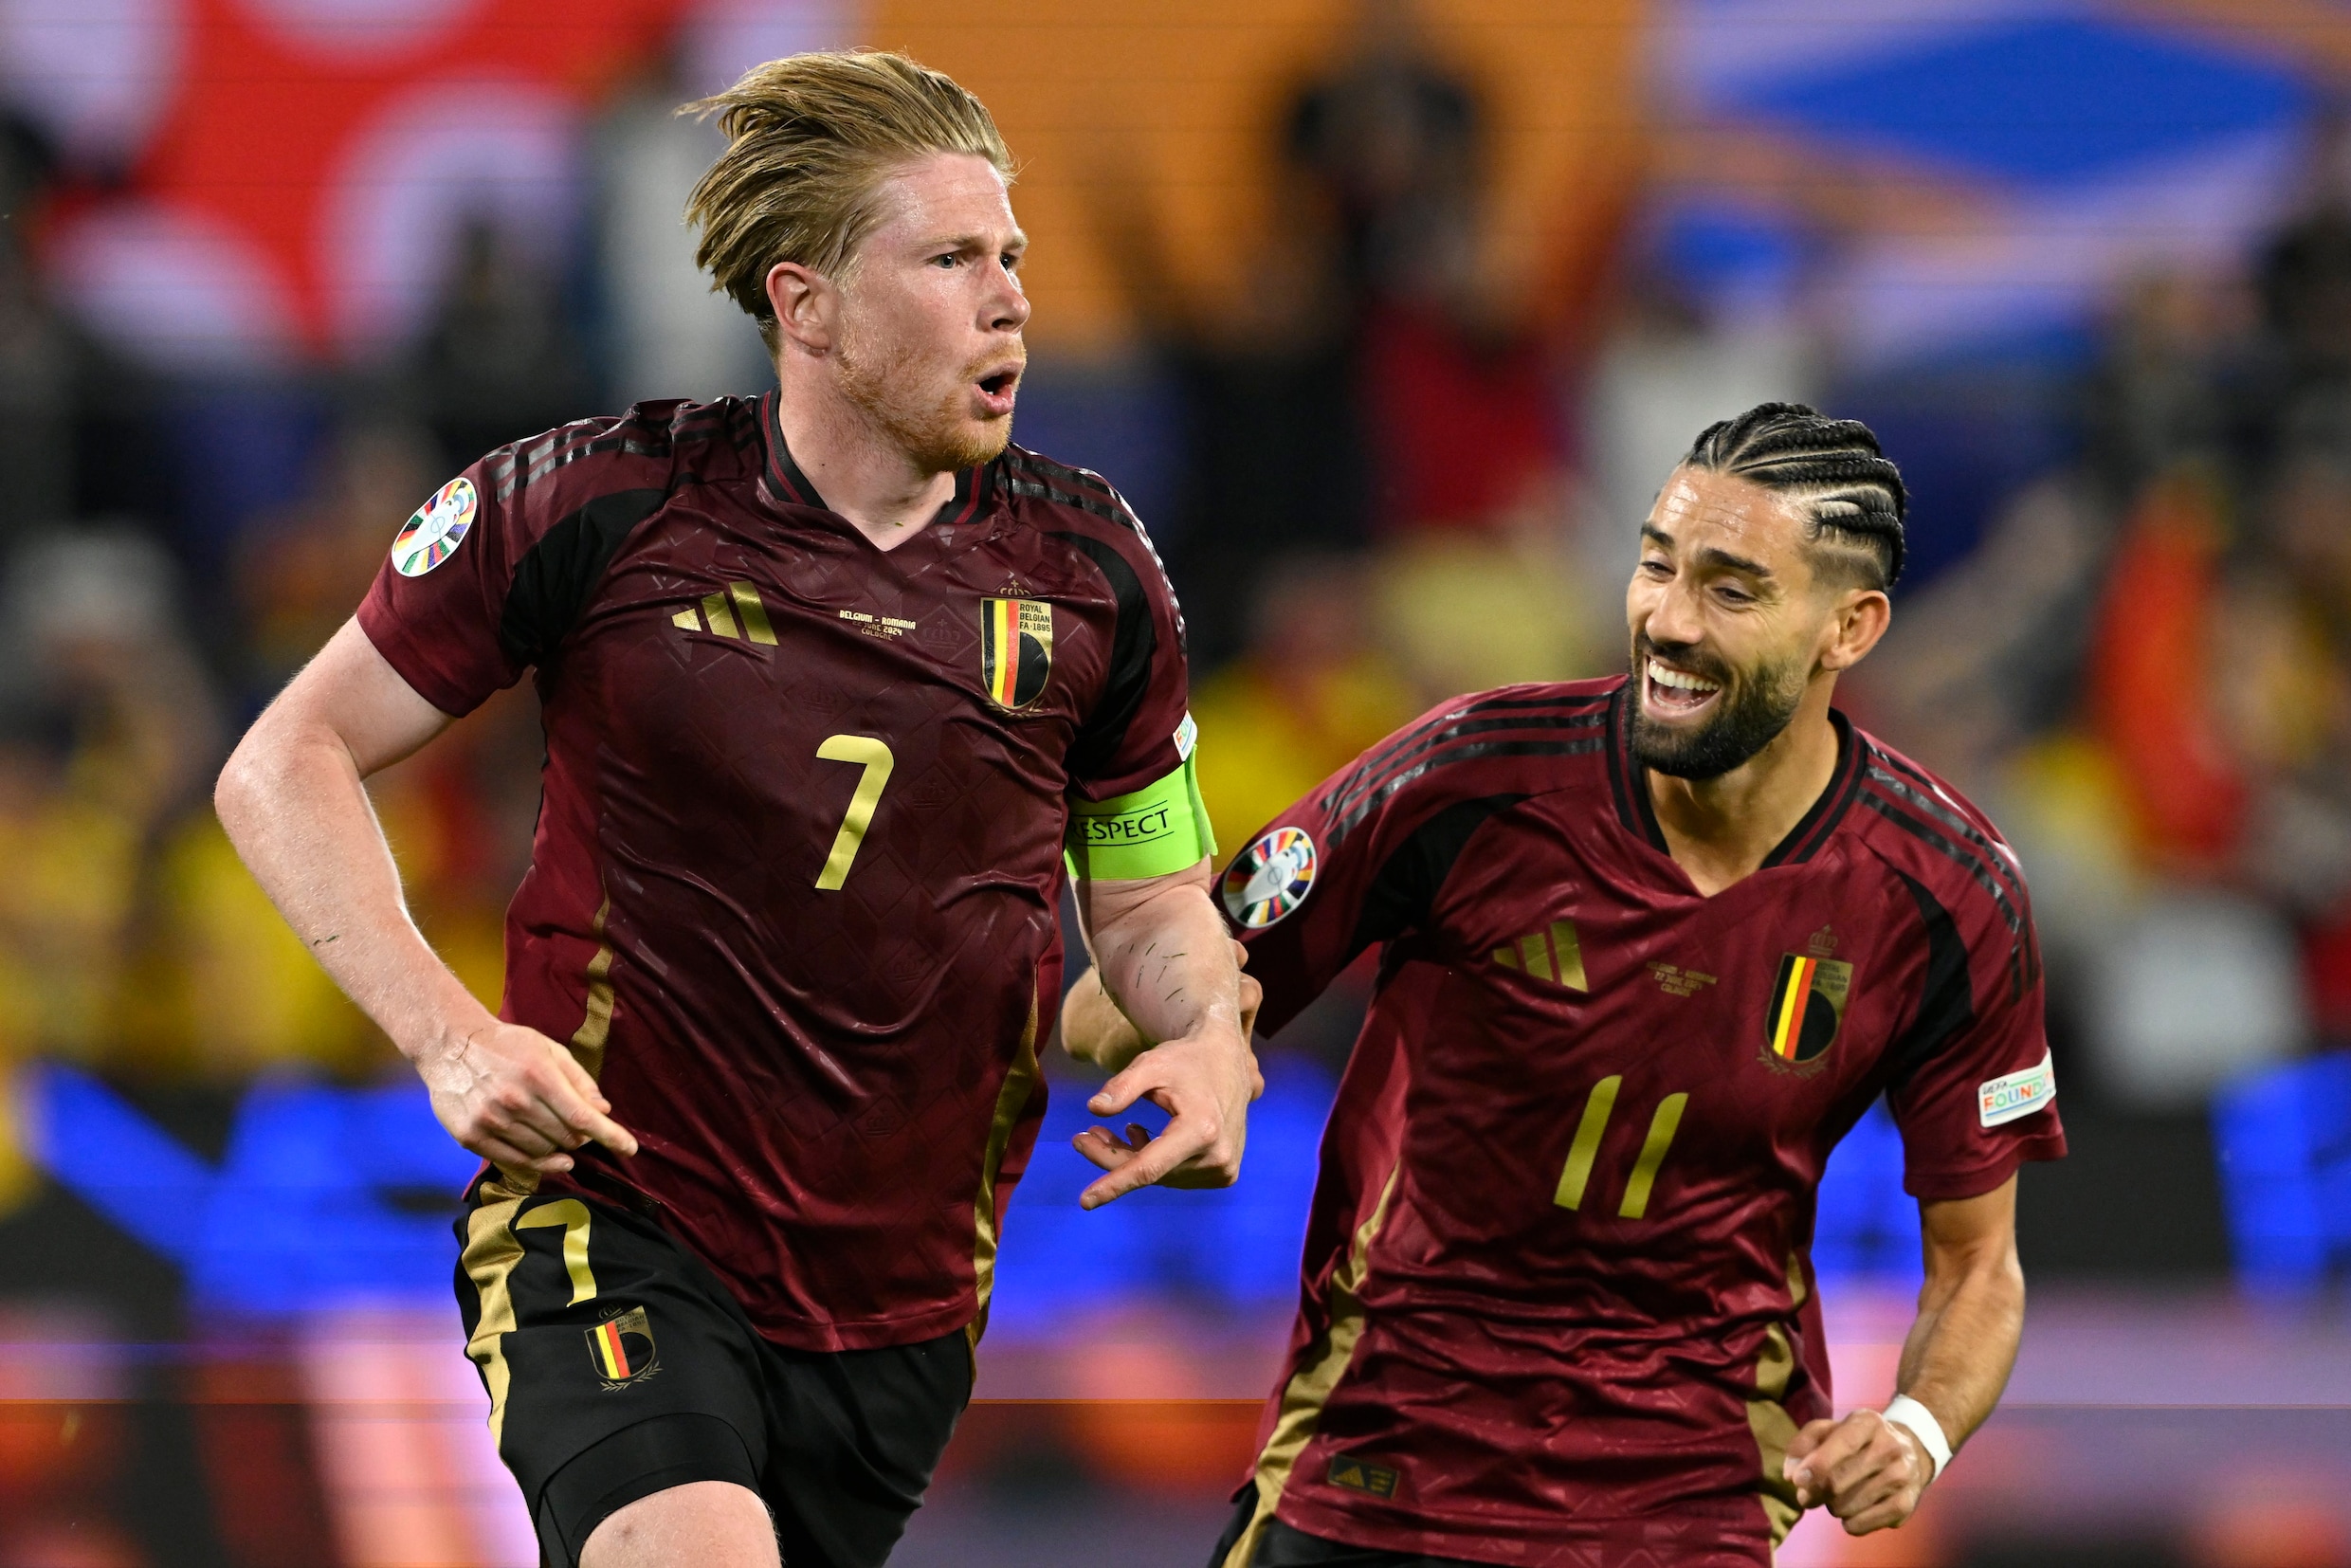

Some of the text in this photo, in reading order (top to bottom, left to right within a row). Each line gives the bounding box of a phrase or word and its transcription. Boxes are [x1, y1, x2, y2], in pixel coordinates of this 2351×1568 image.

[1019, 603, 1043, 614] ROYAL
[1019, 611, 1050, 623] BELGIAN
[839, 610, 873, 623] BELGIUM
[882, 616, 917, 630] ROMANIA
[861, 628, 893, 642] COLOGNE
[883, 625, 902, 636] 2024
[814, 734, 895, 891] 7
[1553, 1074, 1689, 1220] 11
[515, 1197, 597, 1308] 7
